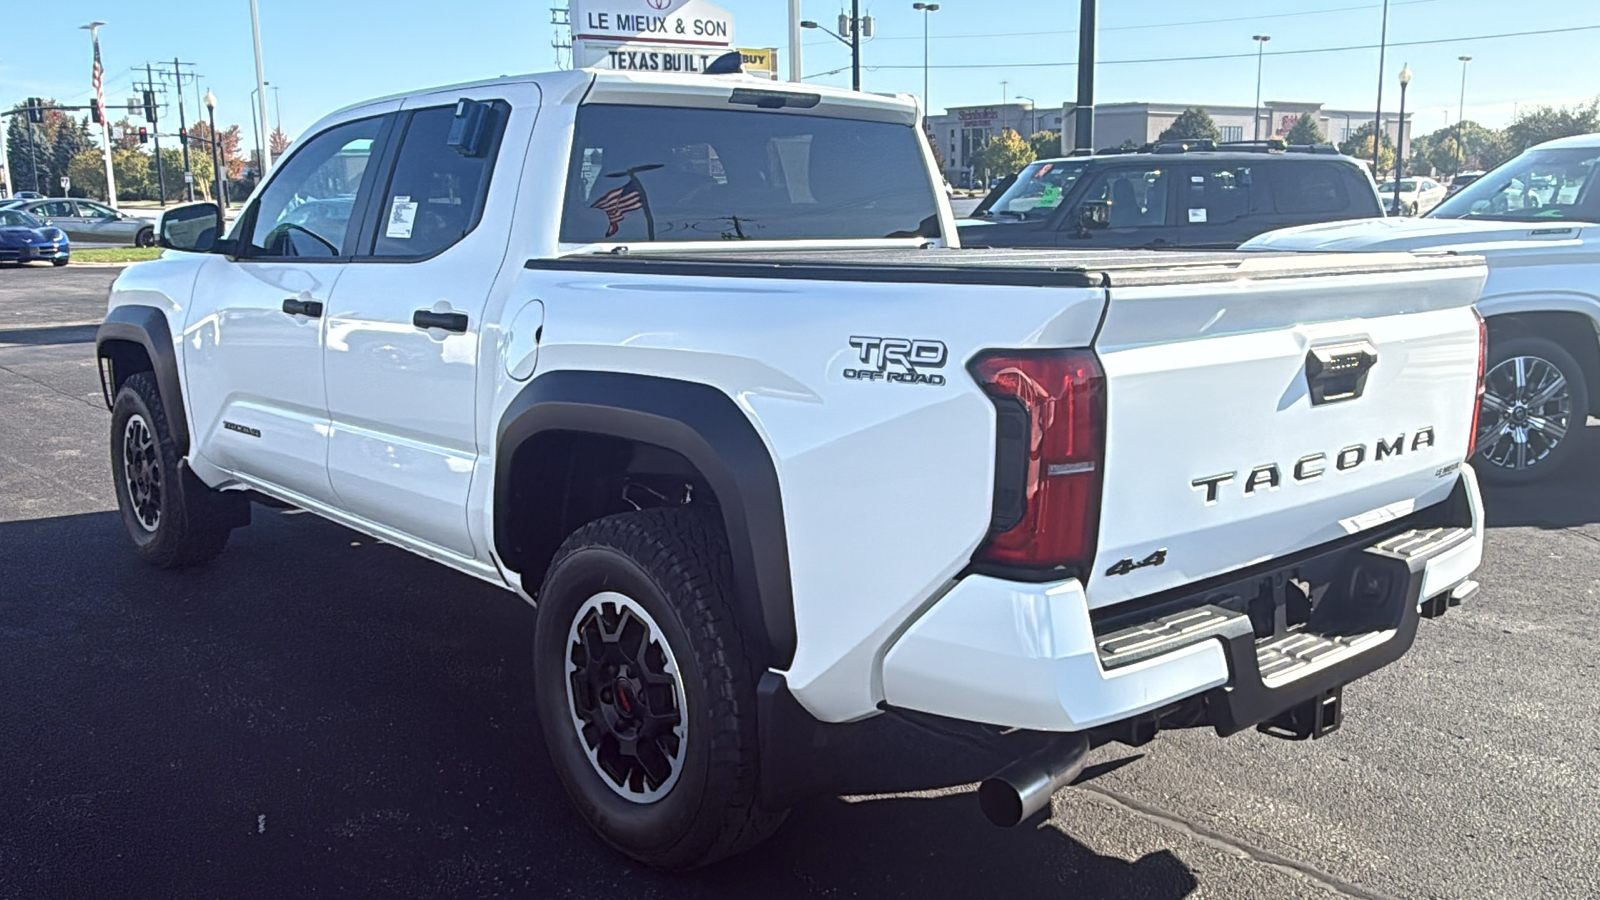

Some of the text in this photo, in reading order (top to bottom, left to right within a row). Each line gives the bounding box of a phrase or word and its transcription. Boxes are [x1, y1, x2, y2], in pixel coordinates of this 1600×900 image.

[588, 12, 727, 37] LE MIEUX & SON
[608, 51, 709, 72] TEXAS BUILT
[742, 54, 766, 66] BUY
[849, 335, 948, 373] TRD
[843, 368, 946, 386] OFF ROAD
[1191, 426, 1435, 504] TACOMA
